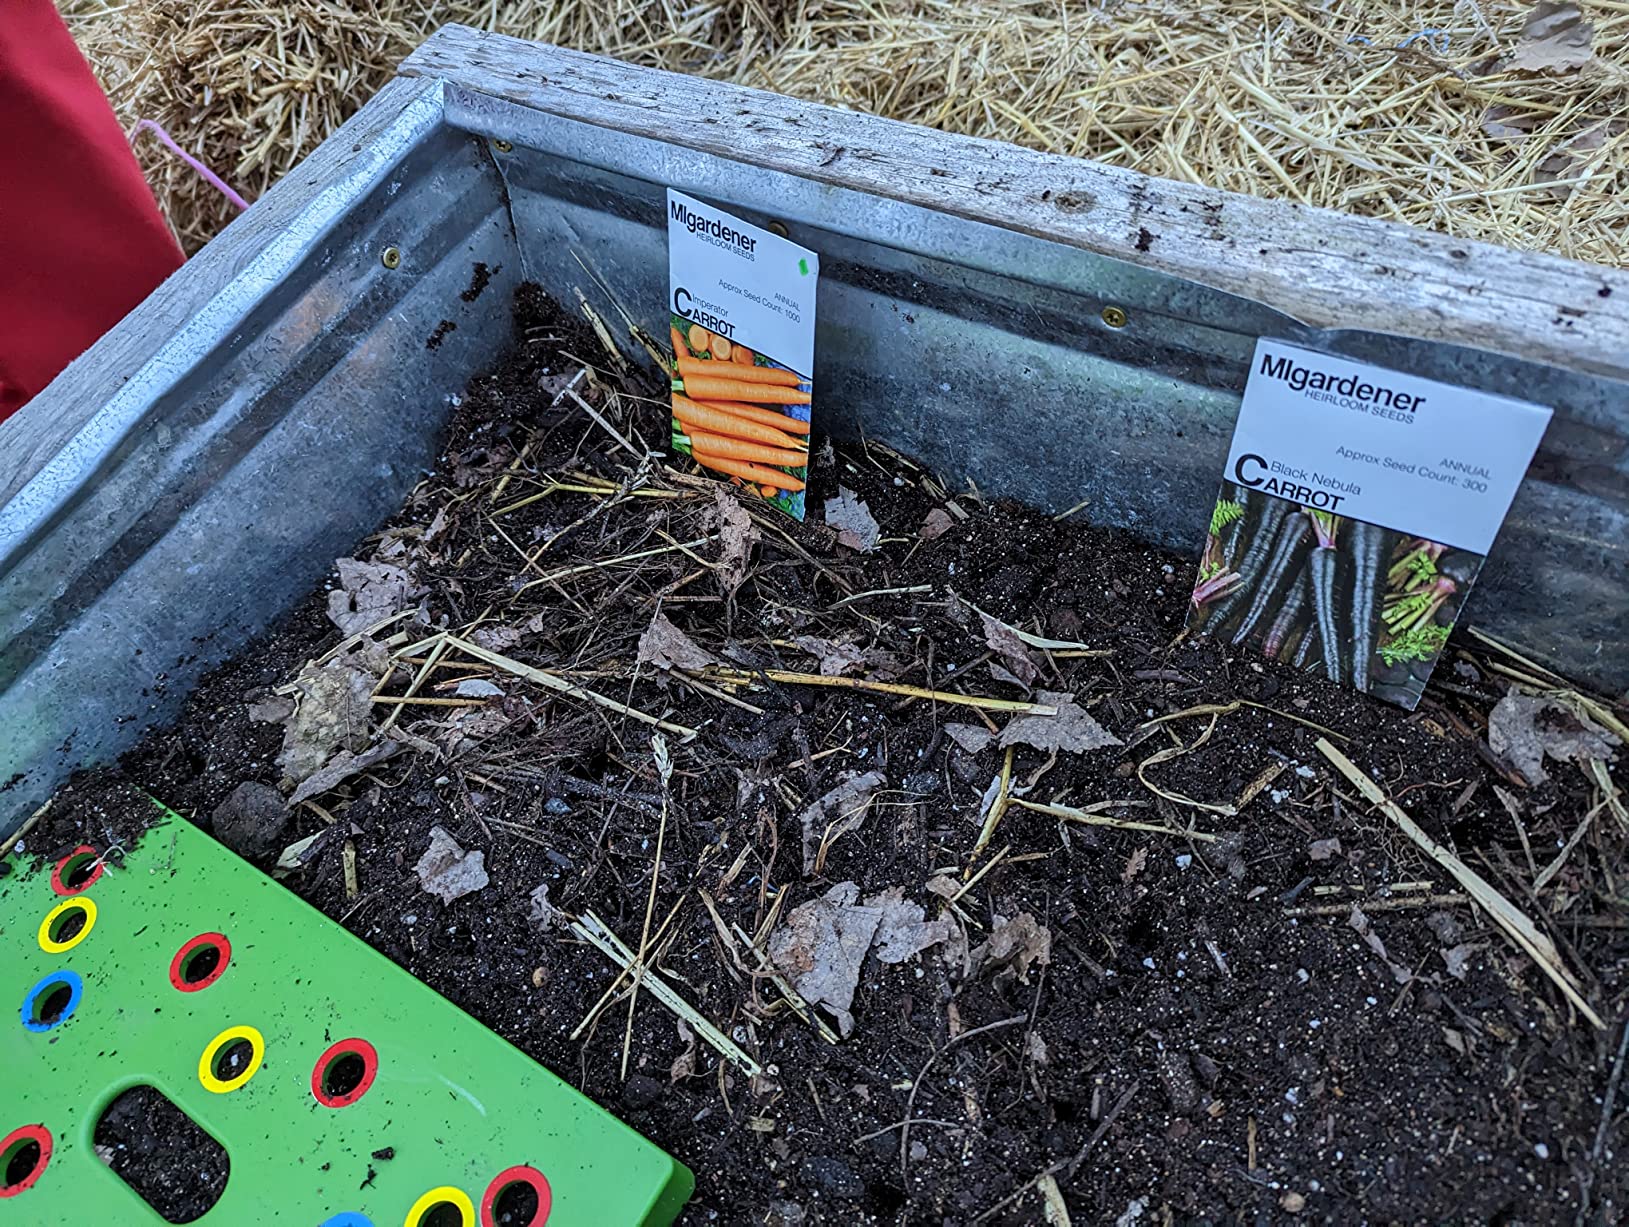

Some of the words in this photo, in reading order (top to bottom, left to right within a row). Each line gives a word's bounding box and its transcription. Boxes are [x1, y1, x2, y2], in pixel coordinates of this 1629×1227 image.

[696, 231, 732, 251] HEIRLOOM
[732, 246, 755, 262] SEEDS
[674, 287, 736, 338] CARROT
[692, 294, 729, 317] Imperator
[718, 279, 743, 295] Approx
[743, 289, 761, 304] Seed
[762, 297, 783, 315] Count:
[785, 309, 801, 323] 1000
[774, 292, 801, 311] ANNUAL
[1304, 388, 1369, 414] HEIRLOOM
[1370, 406, 1414, 425] SEEDS
[1234, 453, 1345, 511] CARROT
[1270, 460, 1310, 482] Black
[1312, 472, 1362, 496] Nebula
[1336, 445, 1380, 467] Approx
[1383, 457, 1416, 474] Seed
[1418, 465, 1459, 486] Count:
[1461, 477, 1488, 494] 300
[1439, 458, 1492, 480] ANNUAL
